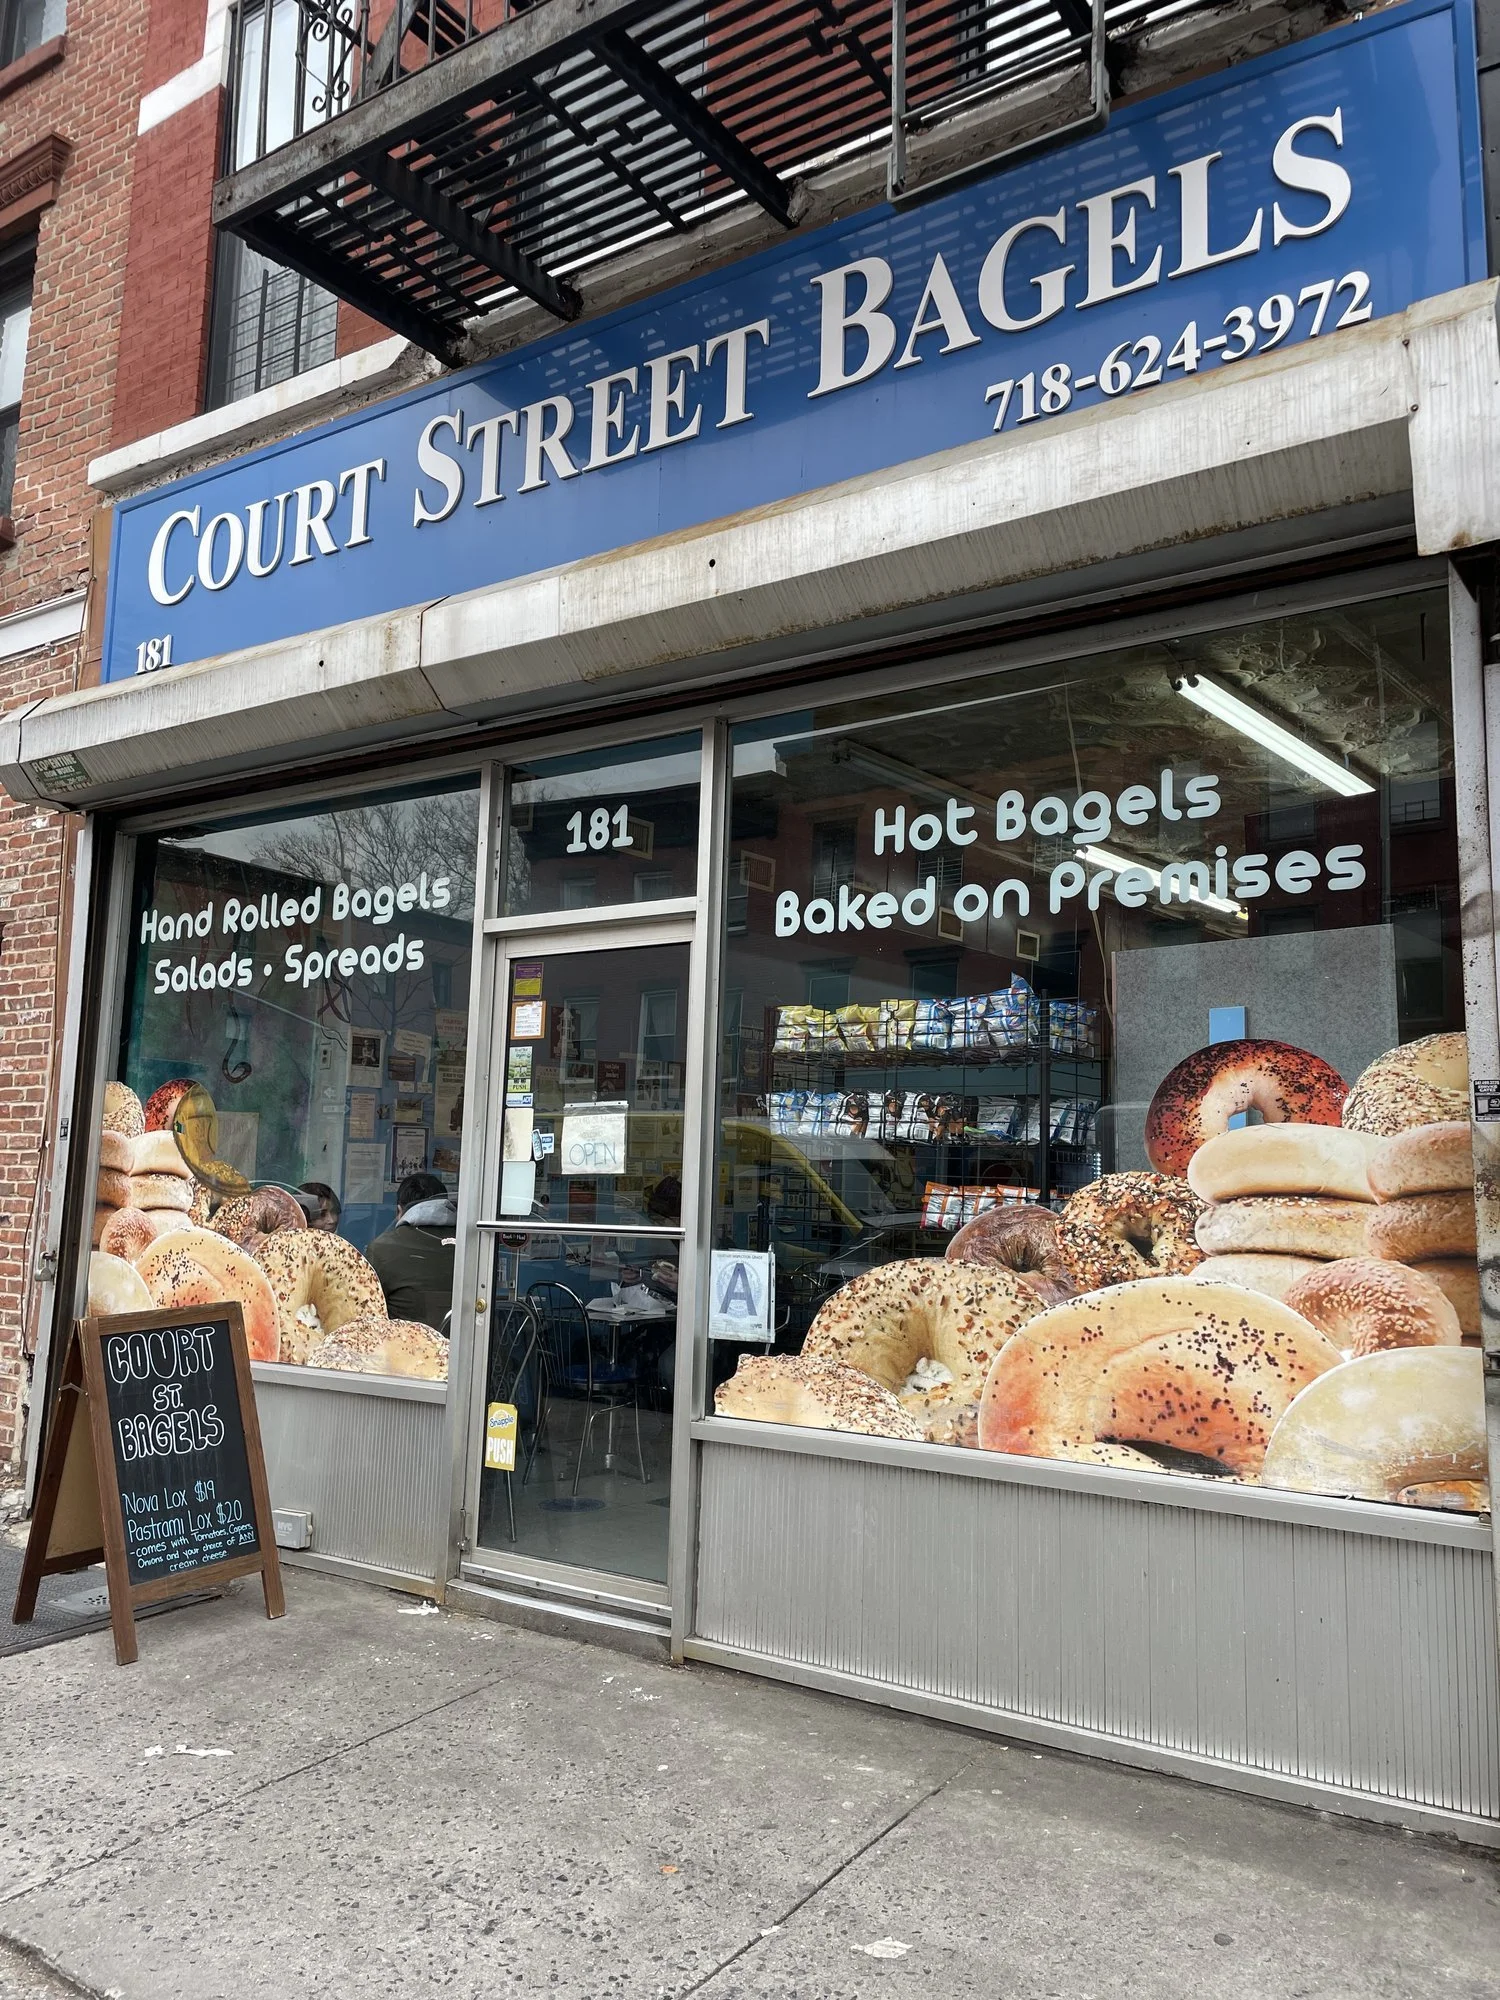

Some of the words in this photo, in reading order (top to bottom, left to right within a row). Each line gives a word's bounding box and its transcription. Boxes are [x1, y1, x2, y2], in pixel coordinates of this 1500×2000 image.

[147, 458, 387, 606] COURT
[412, 318, 771, 528] STREET
[807, 106, 1352, 399] BAGELS
[984, 270, 1374, 432] 718-624-3972
[134, 634, 174, 675] 181
[566, 804, 634, 854] 181
[874, 798, 979, 856] Hot
[996, 768, 1222, 845] Bagels
[141, 907, 213, 945] Hand
[222, 886, 322, 934] Rolled
[332, 871, 451, 926] Bagels
[775, 875, 936, 938] Baked
[953, 878, 1030, 923] on
[1050, 843, 1367, 915] Premises
[153, 951, 253, 995] Salads
[283, 932, 425, 989] Spreads
[569, 1141, 617, 1166] OPEN
[718, 1262, 758, 1317] A
[107, 1326, 216, 1384] COURT
[152, 1383, 184, 1411] ST.
[117, 1404, 225, 1461] BAGELS
[489, 1414, 514, 1428] Snapple
[486, 1436, 514, 1466] PUSH
[122, 1491, 159, 1515] Nova
[163, 1487, 188, 1510] Lox
[194, 1480, 216, 1503] $19
[127, 1518, 185, 1543] Pastrami
[188, 1510, 213, 1533] Lox
[215, 1499, 243, 1525] $20
[137, 1556, 163, 1569] Onions
[166, 1550, 180, 1561] and
[182, 1547, 200, 1560] your
[202, 1541, 223, 1552] choice
[226, 1537, 236, 1547] of
[238, 1531, 256, 1542] ANY
[169, 1559, 198, 1572] cream
[170, 1537, 190, 1549] with
